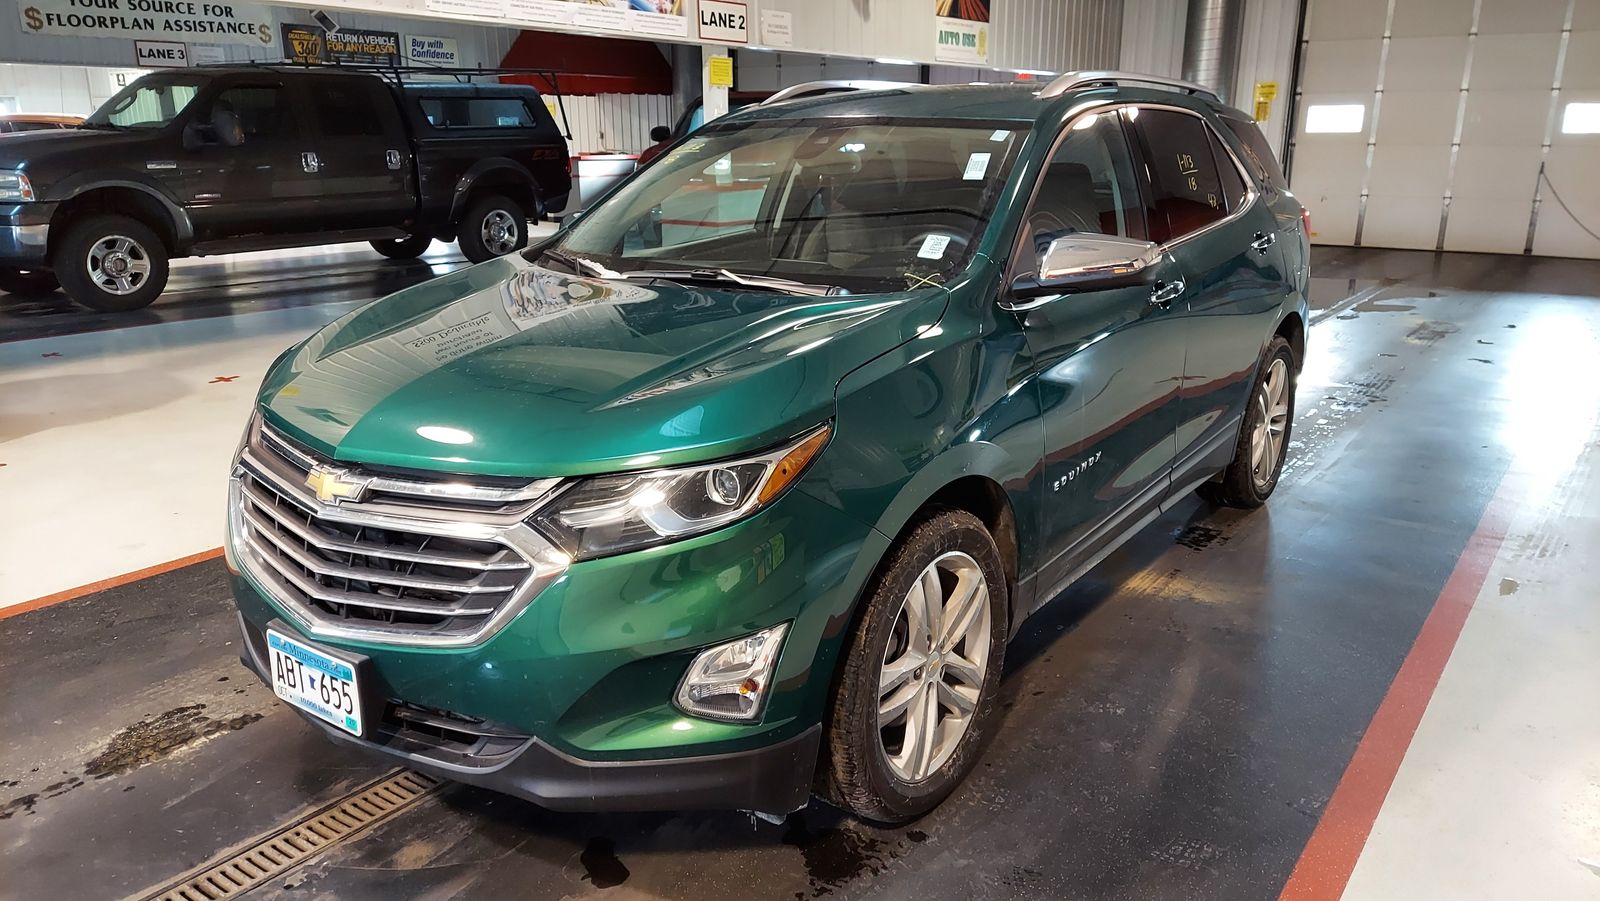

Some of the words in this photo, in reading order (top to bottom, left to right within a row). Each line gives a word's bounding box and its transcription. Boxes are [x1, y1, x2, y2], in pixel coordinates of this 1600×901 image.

[128, 0, 196, 15] SOURCE
[203, 4, 234, 18] FOR
[46, 13, 155, 31] FLOORPLAN
[163, 19, 256, 35] ASSISTANCE
[701, 10, 736, 29] LANE
[738, 14, 746, 29] 2
[326, 32, 359, 43] RETURN
[364, 36, 395, 45] VEHICLE
[412, 38, 427, 50] Buy
[429, 40, 444, 50] with
[938, 30, 960, 46] AUTO
[962, 33, 976, 48] USE
[139, 48, 176, 60] LANE
[177, 49, 185, 60] 3
[298, 41, 317, 56] 360
[327, 42, 345, 51] FOR
[345, 43, 363, 53] ANY
[363, 44, 397, 54] REASON
[411, 48, 455, 60] Confidence
[1188, 176, 1198, 191] 18
[1053, 450, 1102, 492] EQUINOX
[288, 642, 329, 670] Minnesota
[276, 651, 304, 693] ABT
[320, 672, 353, 715] 655
